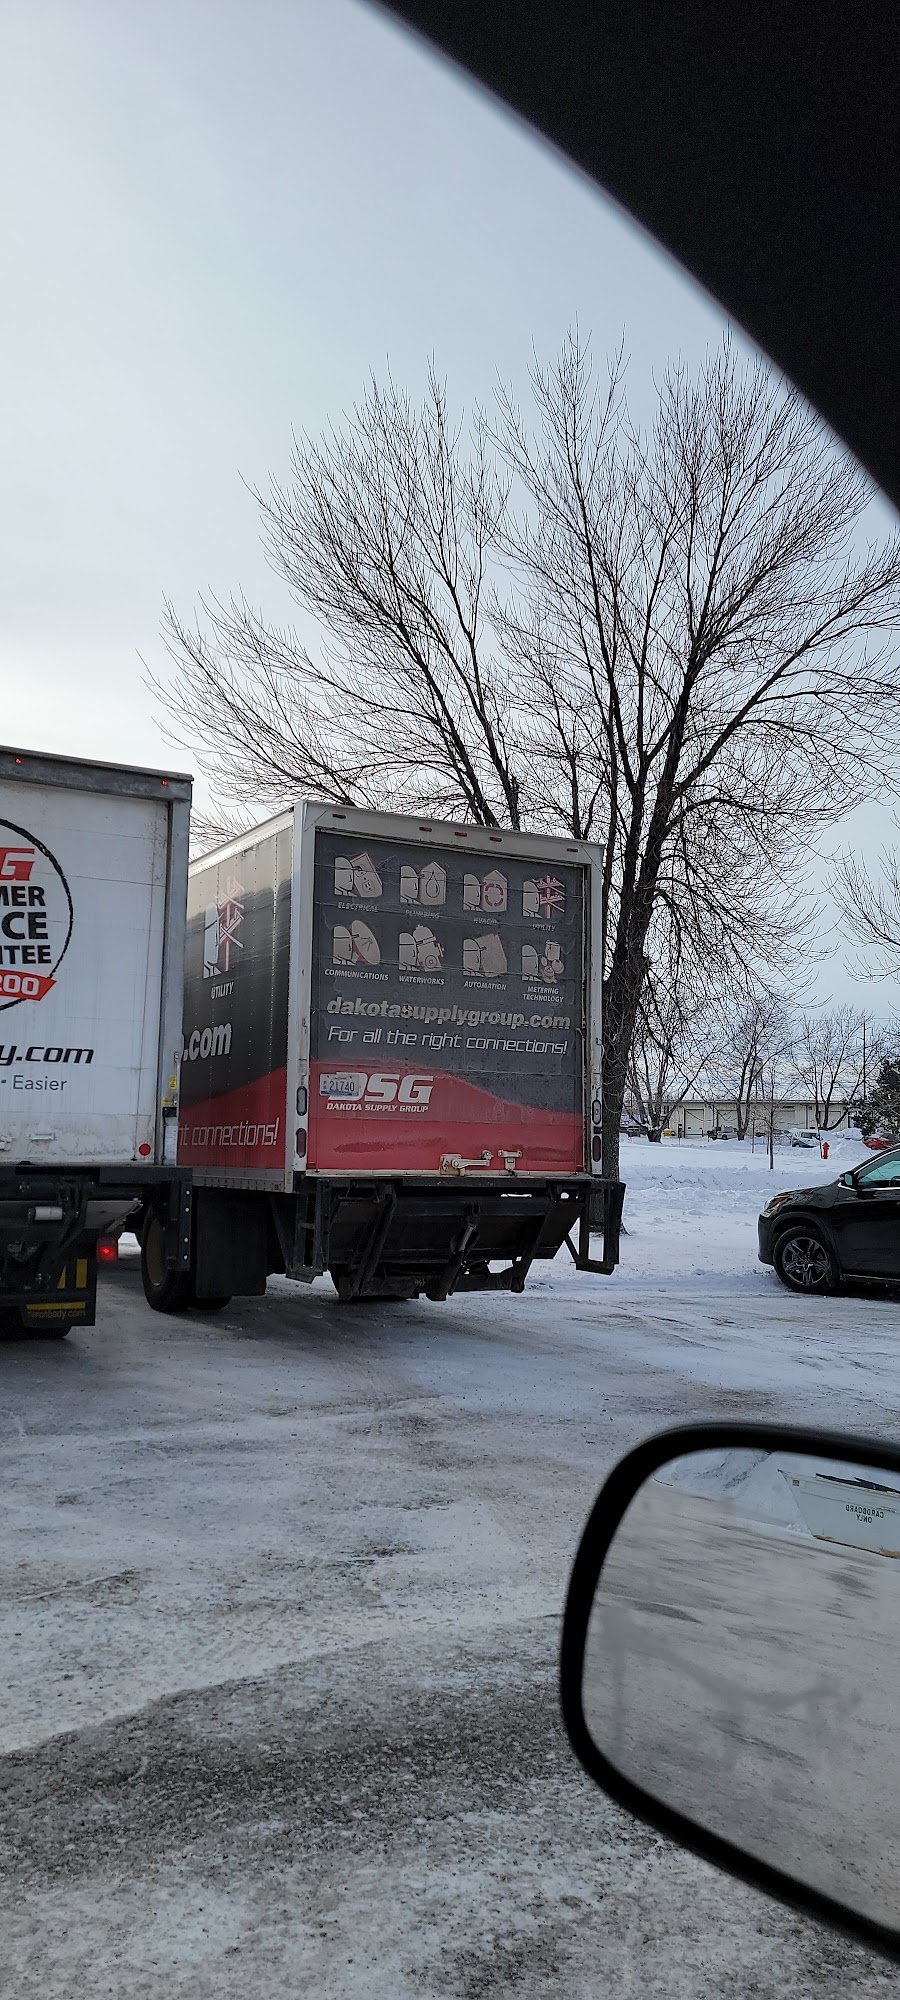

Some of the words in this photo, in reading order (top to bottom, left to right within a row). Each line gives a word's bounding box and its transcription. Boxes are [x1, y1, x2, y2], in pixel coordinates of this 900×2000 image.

[337, 902, 379, 913] ELECTRICAL
[532, 923, 556, 932] UTILITY
[0, 944, 52, 965] TEE
[324, 968, 389, 981] COMMUNICATIONS
[399, 976, 445, 986] WATERWORKS
[0, 973, 40, 997] 00
[212, 982, 234, 999] UTILITY
[463, 981, 507, 991] AUTOMATION
[527, 986, 560, 995] METERING
[522, 993, 564, 1003] TECHNOLOGY
[327, 997, 571, 1029] dakotasupplygroup.com
[181, 1023, 232, 1061] .com
[328, 1026, 358, 1042] For
[363, 1028, 382, 1043] all
[387, 1030, 417, 1046] the
[421, 1032, 462, 1049] right
[466, 1036, 568, 1054] connections!
[13, 1075, 68, 1091] Easier
[329, 1081, 355, 1092] 21740
[327, 1102, 362, 1111] DAKOTA
[364, 1104, 398, 1112] SUPPLY
[399, 1105, 429, 1113] GROUP
[191, 1117, 280, 1146] connections!
